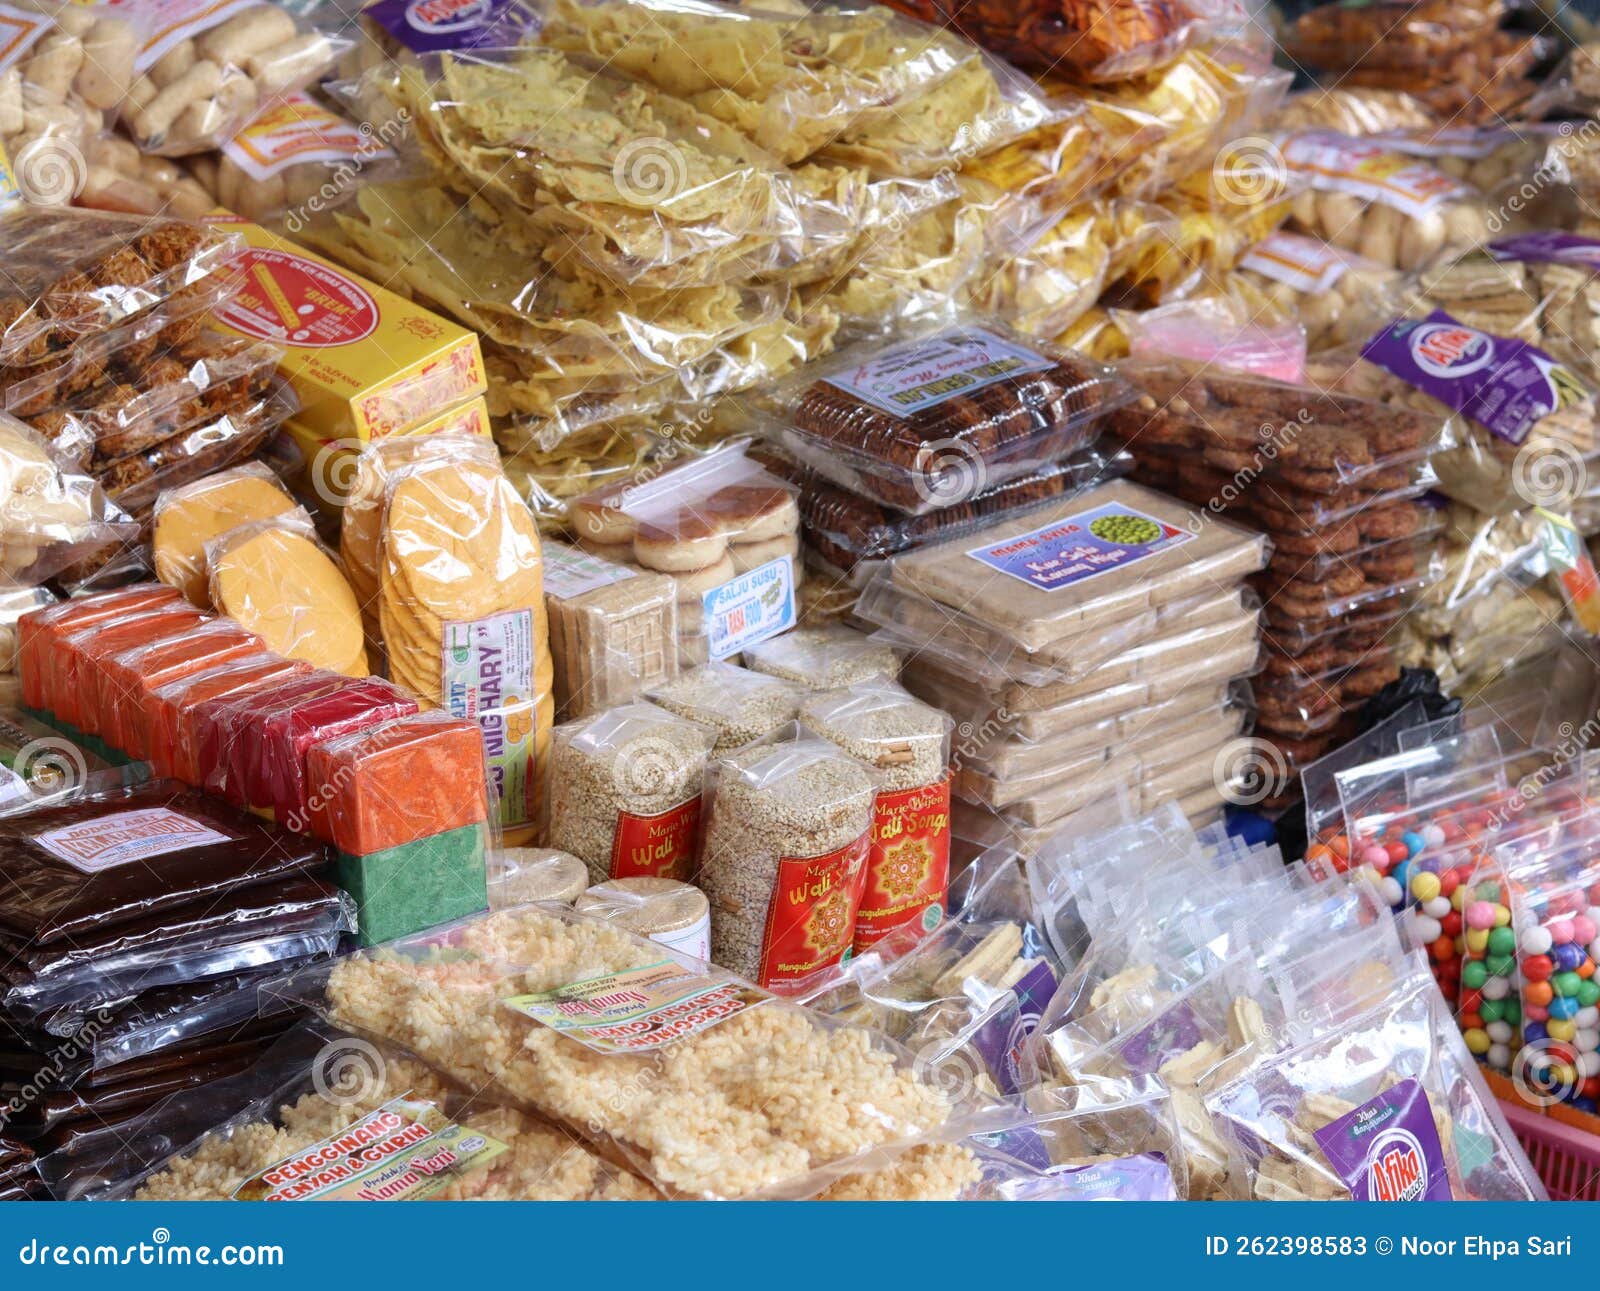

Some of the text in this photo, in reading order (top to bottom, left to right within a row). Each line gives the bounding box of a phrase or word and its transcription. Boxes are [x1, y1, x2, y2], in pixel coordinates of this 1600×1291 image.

[718, 579, 750, 605] SALJU
[751, 567, 778, 588] SUSU
[632, 835, 674, 866] Wali
[788, 873, 831, 905] Wali
[1356, 1107, 1378, 1123] Khas
[346, 1157, 364, 1172] &
[362, 1122, 432, 1163] GURIH
[1372, 1148, 1420, 1201] Afika
